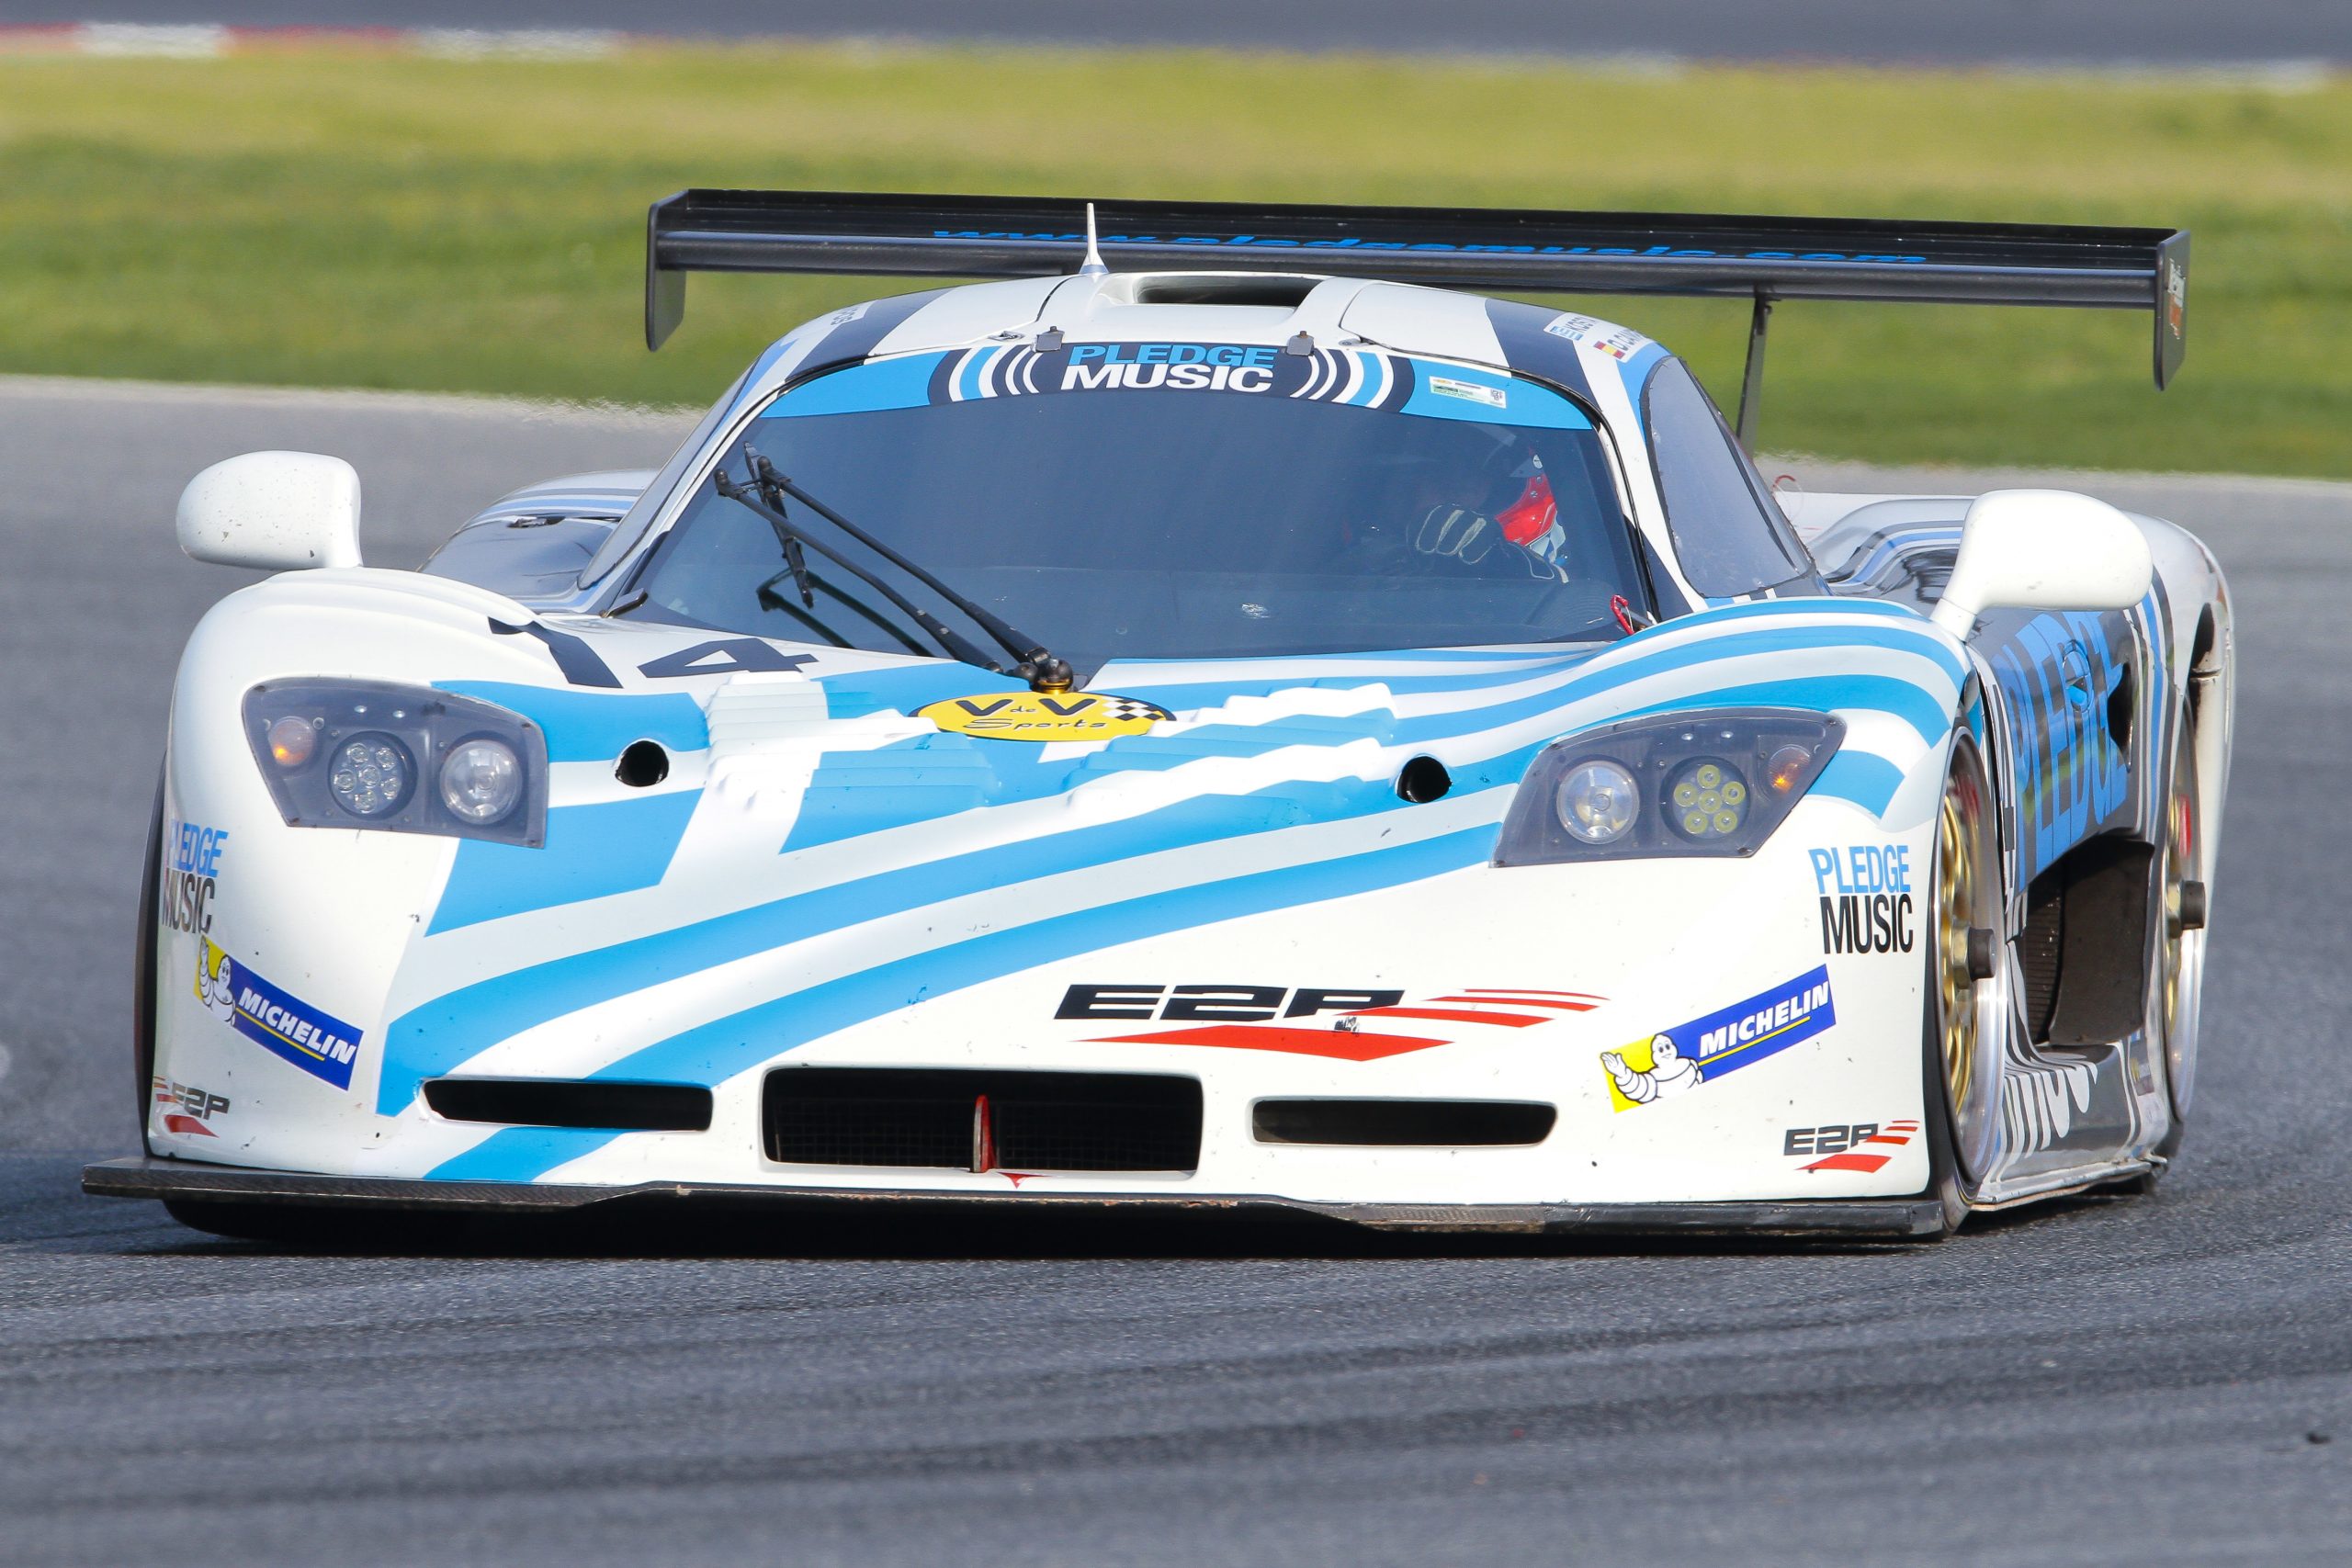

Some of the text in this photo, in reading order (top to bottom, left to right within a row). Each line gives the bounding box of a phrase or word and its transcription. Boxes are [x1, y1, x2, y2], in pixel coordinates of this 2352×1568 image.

[1069, 344, 1278, 368] PLEDGE
[1060, 363, 1273, 393] MUSIC
[955, 698, 1098, 716] V de V
[963, 717, 1109, 730] Sports
[1807, 844, 1912, 895] PLEDGE
[1819, 893, 1915, 954] MUSIC
[1053, 984, 1406, 1022] E2P
[1698, 980, 1829, 1058] MICHELIN
[238, 987, 357, 1066] MICHELIN
[171, 1081, 232, 1121] E2P
[1783, 1122, 1879, 1156] E2P
